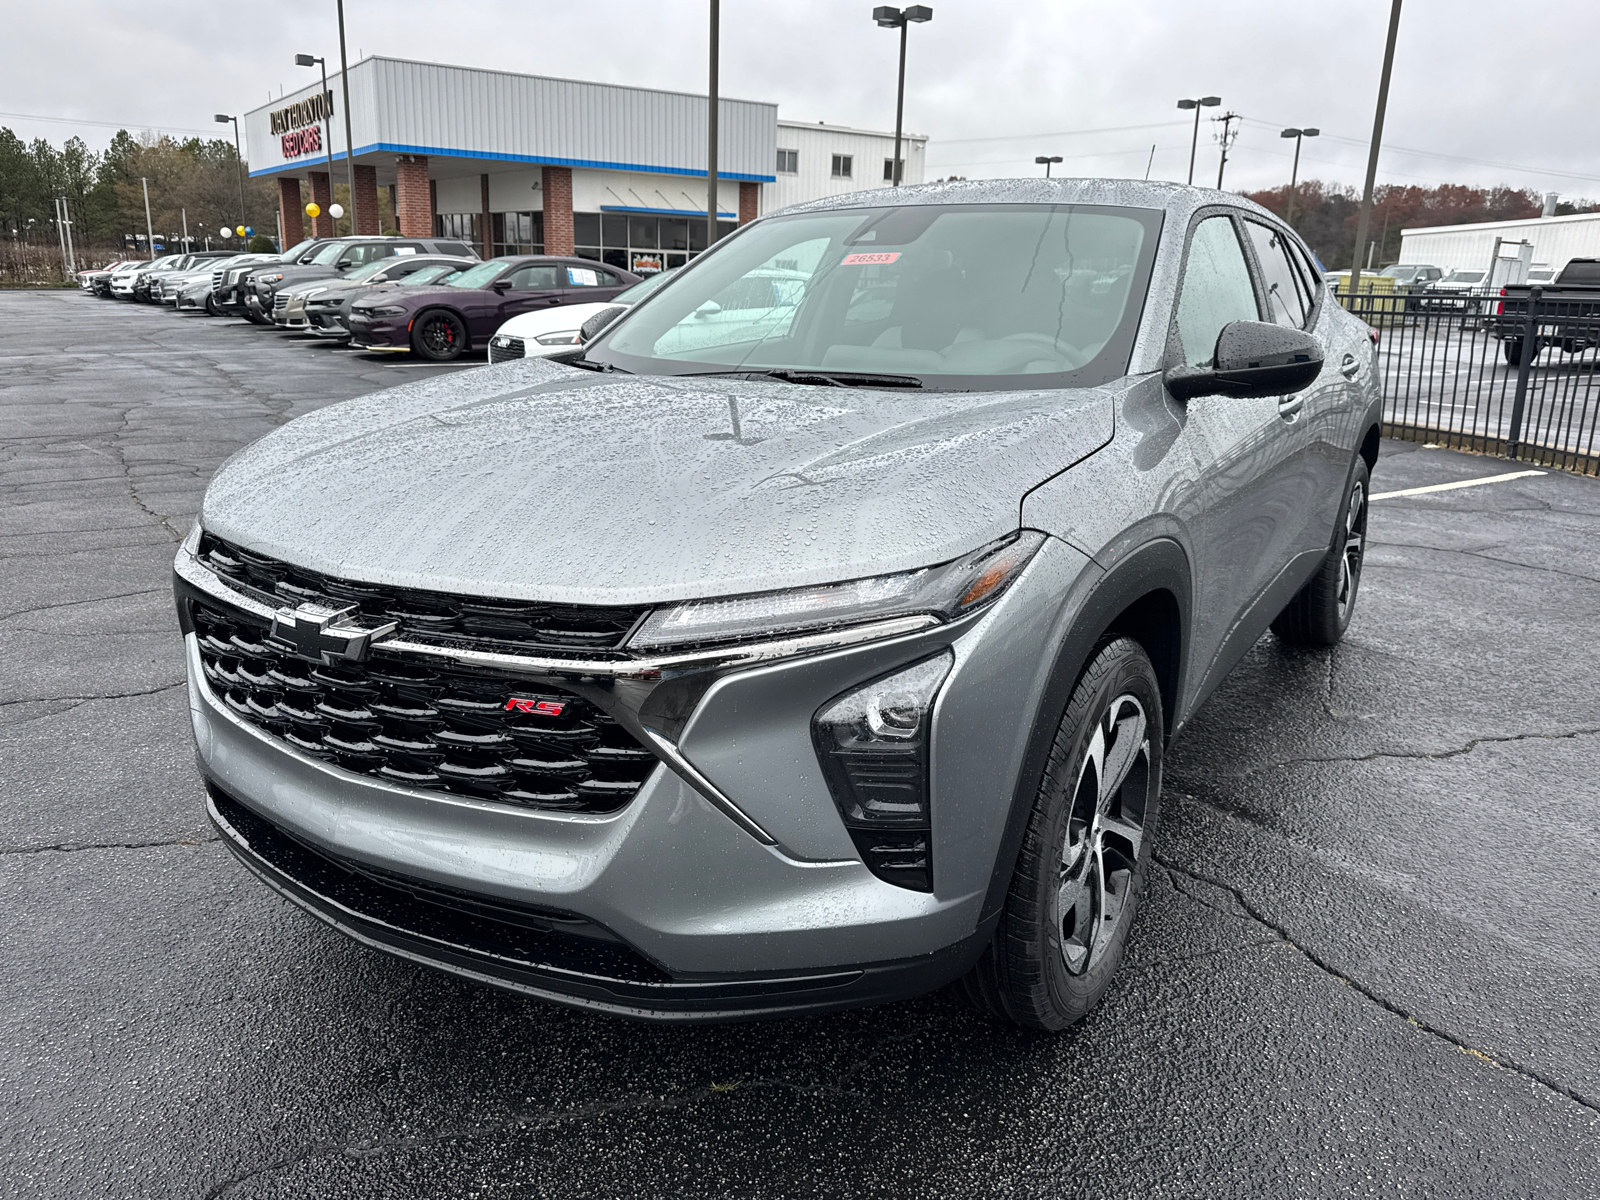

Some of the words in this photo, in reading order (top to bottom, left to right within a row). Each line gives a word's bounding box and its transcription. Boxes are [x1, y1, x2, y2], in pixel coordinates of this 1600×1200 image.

[281, 132, 300, 158] USED
[299, 125, 322, 153] CARS
[849, 254, 890, 263] 26533
[504, 697, 566, 716] RS
